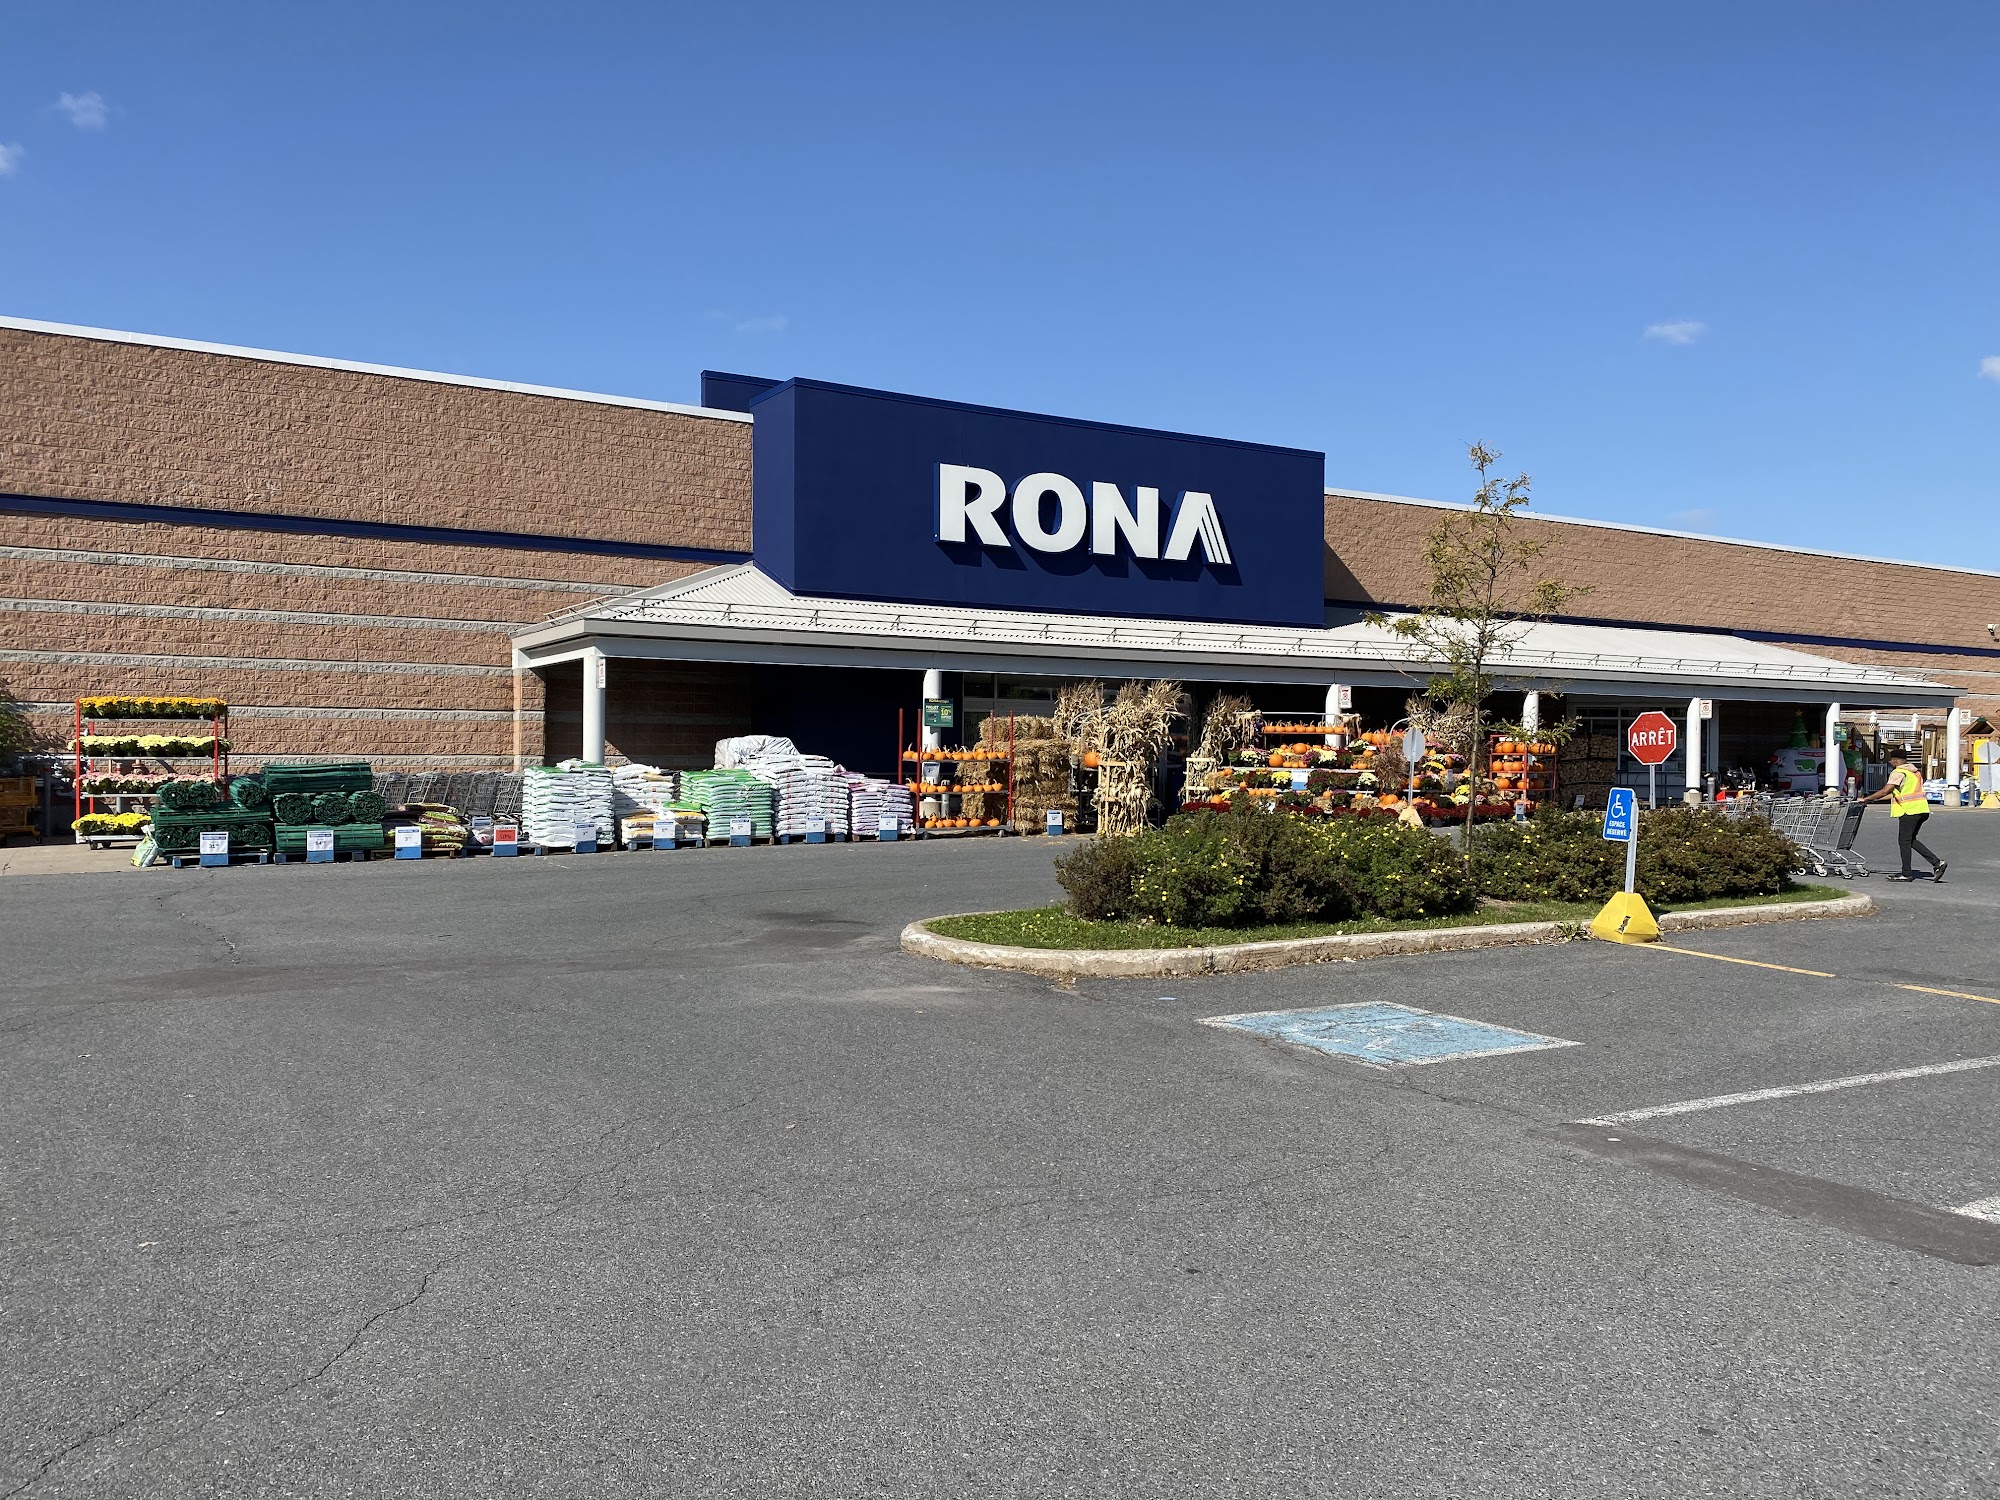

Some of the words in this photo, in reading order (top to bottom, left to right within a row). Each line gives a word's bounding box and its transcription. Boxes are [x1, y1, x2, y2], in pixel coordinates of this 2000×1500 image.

[936, 462, 1232, 565] RONA
[1631, 727, 1674, 747] ARRÊT
[1609, 820, 1626, 828] ESPACE
